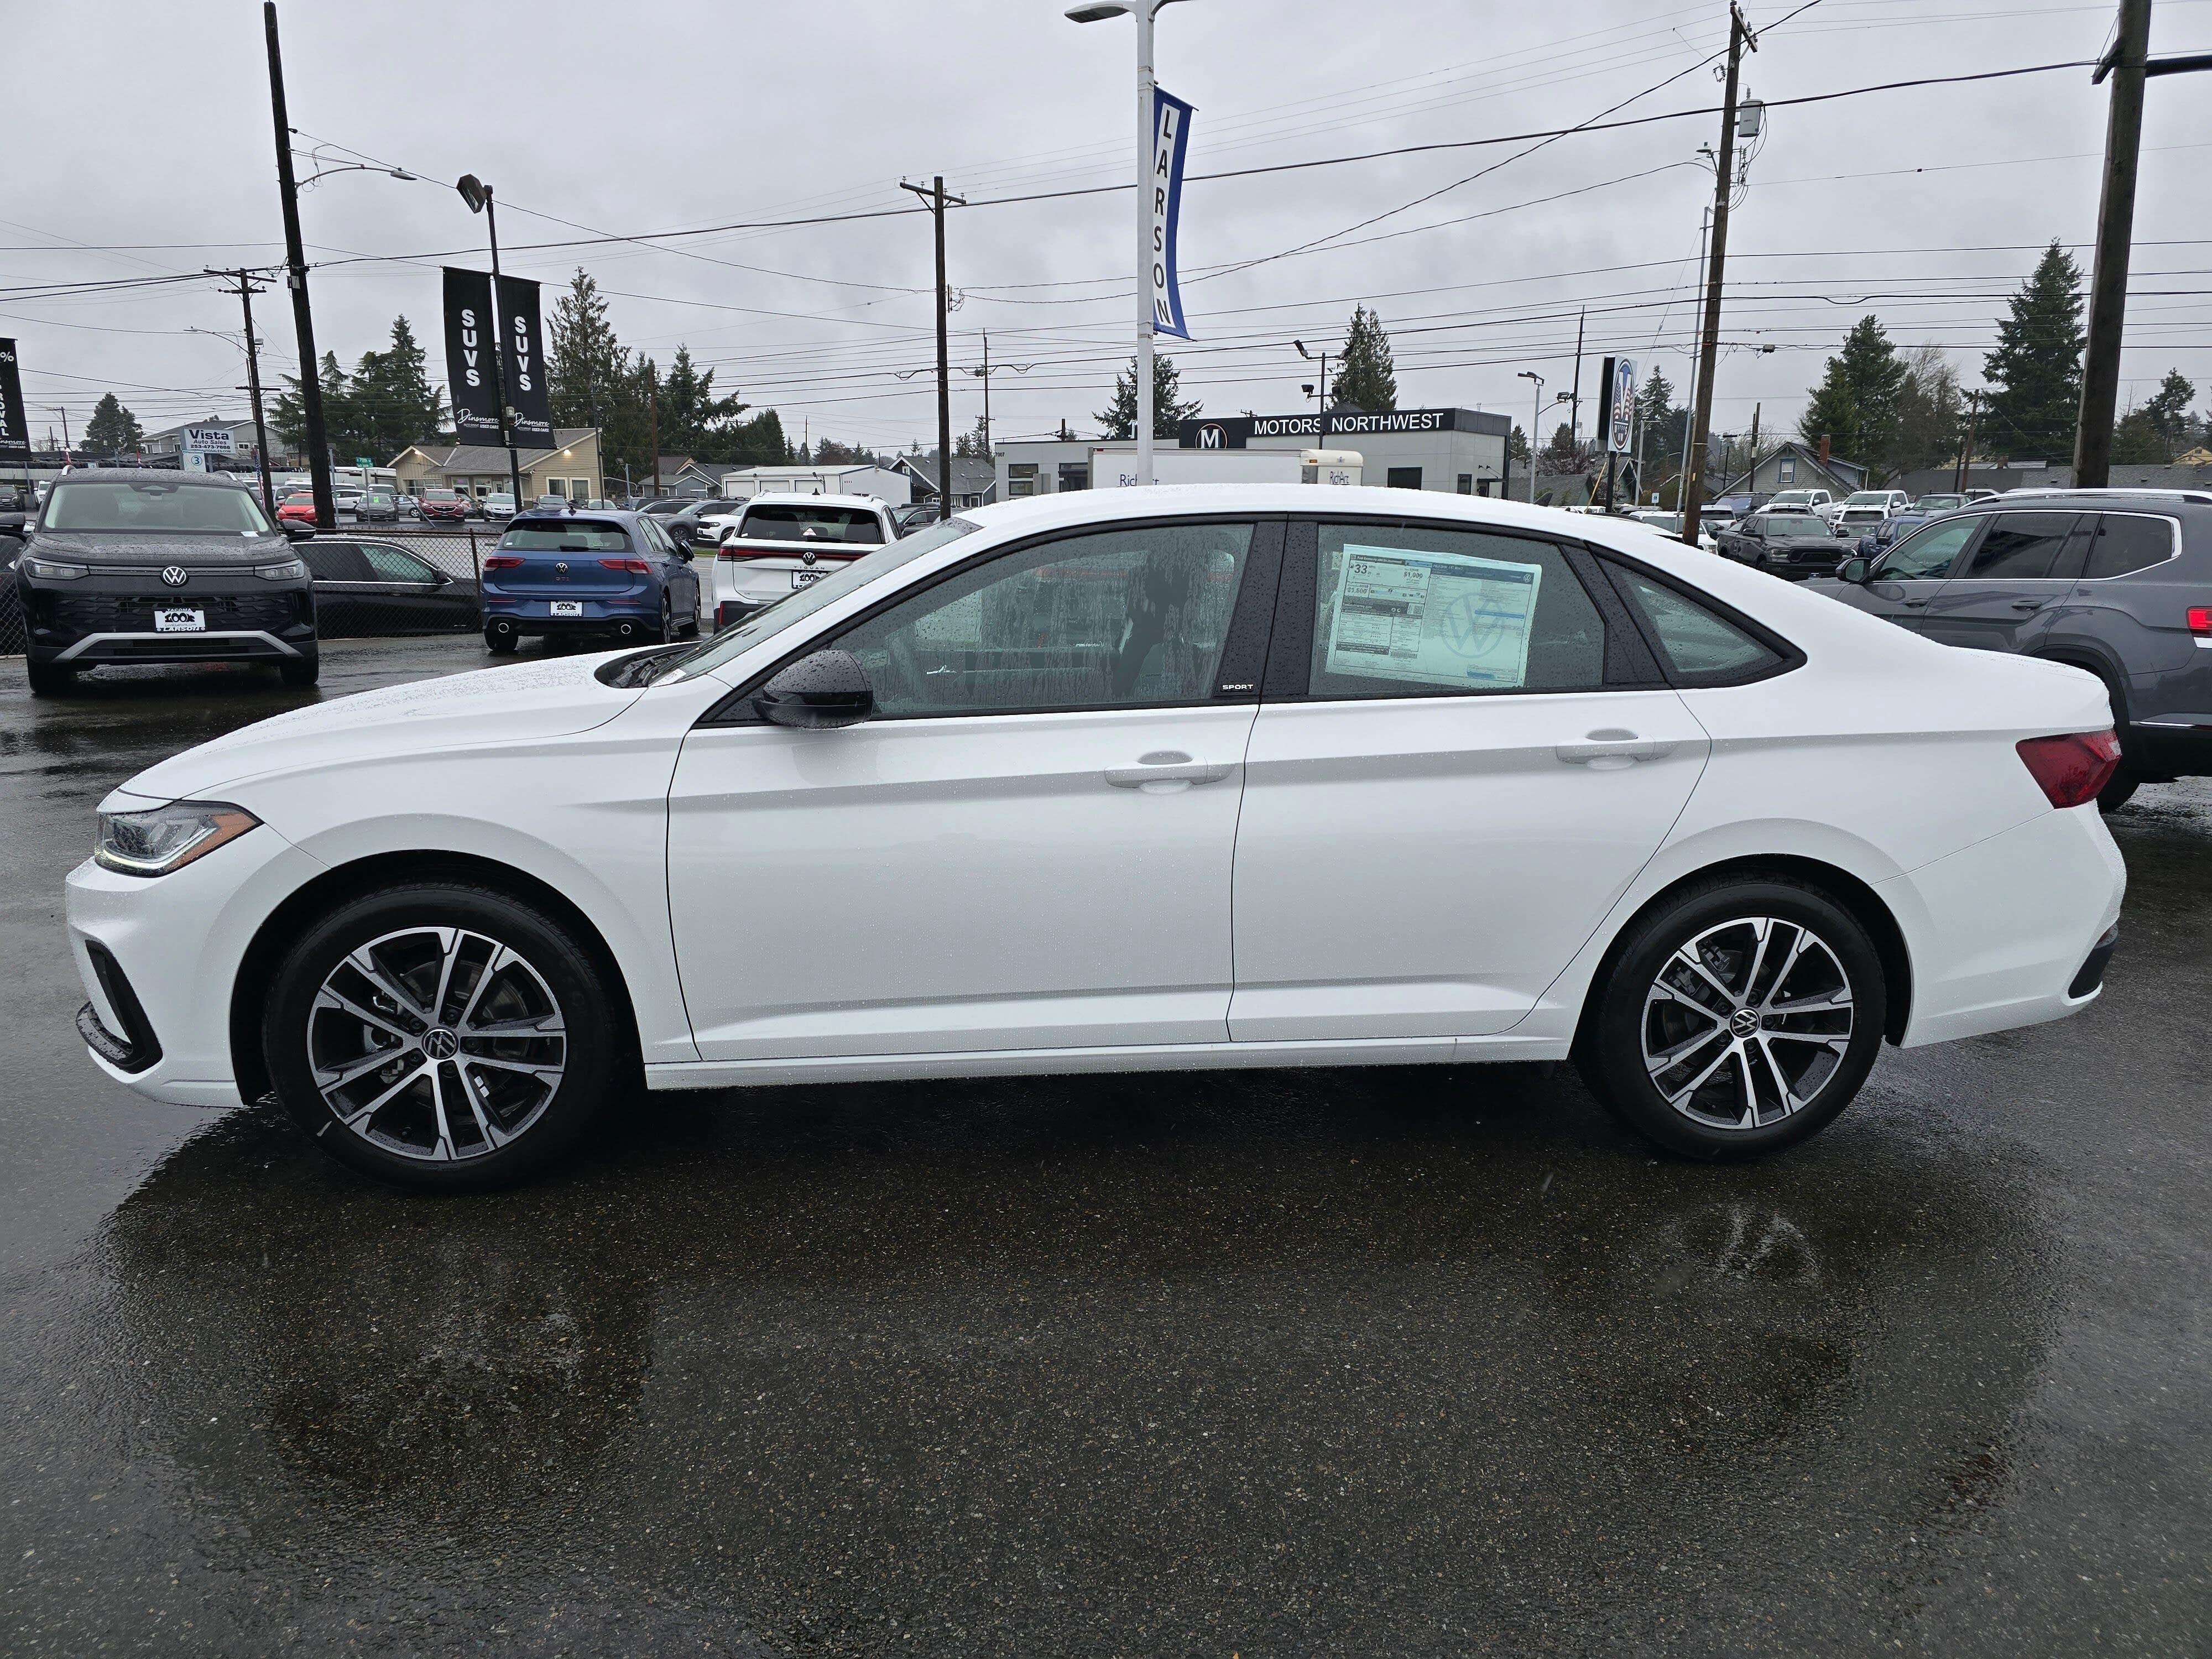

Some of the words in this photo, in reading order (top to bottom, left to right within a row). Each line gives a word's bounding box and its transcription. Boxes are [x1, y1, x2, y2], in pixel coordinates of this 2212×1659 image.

[1154, 109, 1172, 325] LARSON
[461, 309, 480, 387] SUVS
[514, 316, 531, 391] SUVS
[457, 408, 499, 424] Dinsmore
[514, 412, 550, 427] Dinsmore
[1254, 419, 1321, 435] MOTORS
[1332, 413, 1444, 432] NORTHWEST
[189, 429, 229, 440] Vista
[1201, 429, 1219, 448] M
[1354, 564, 1368, 574] 33
